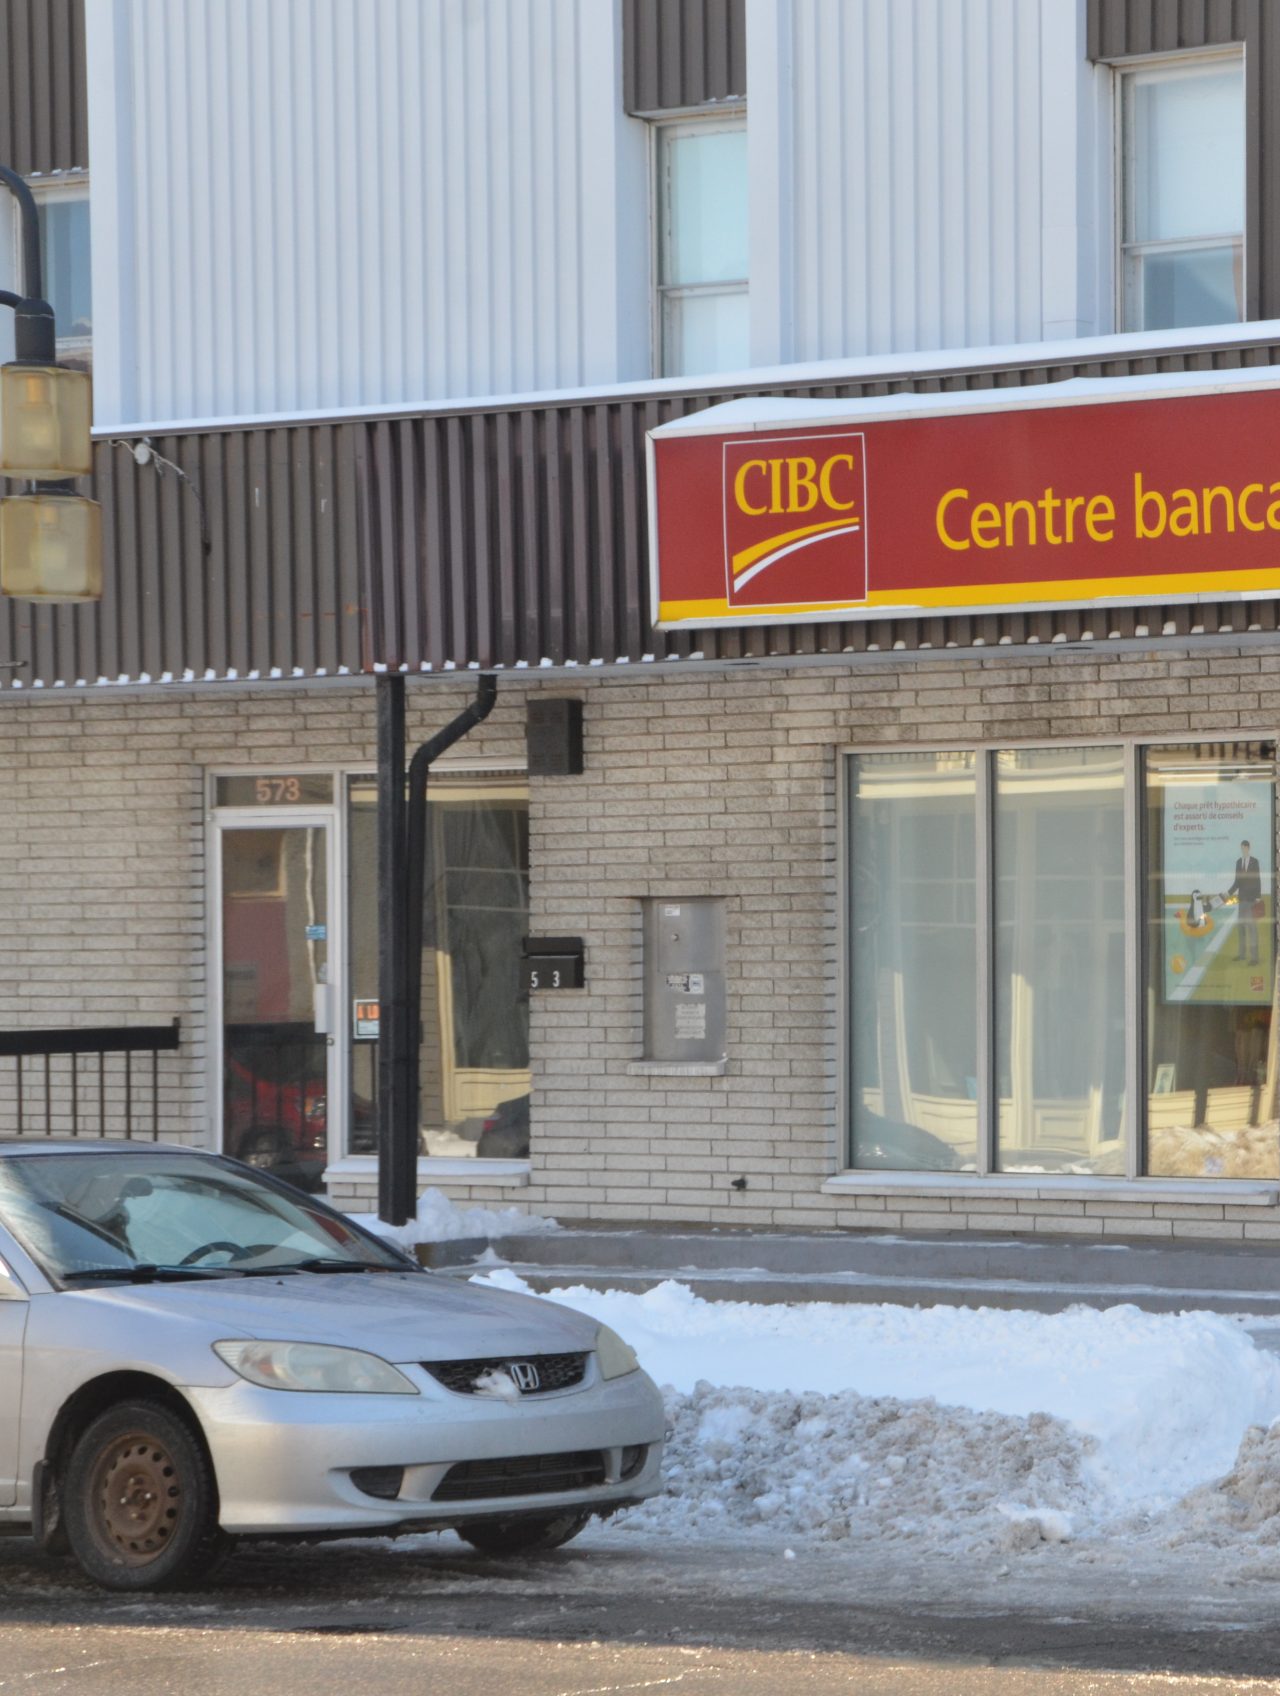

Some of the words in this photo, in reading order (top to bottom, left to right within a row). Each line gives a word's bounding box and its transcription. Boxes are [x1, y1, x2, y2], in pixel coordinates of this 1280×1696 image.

[736, 455, 855, 515] CIBC
[937, 489, 1117, 550] Centre
[256, 778, 300, 801] 573
